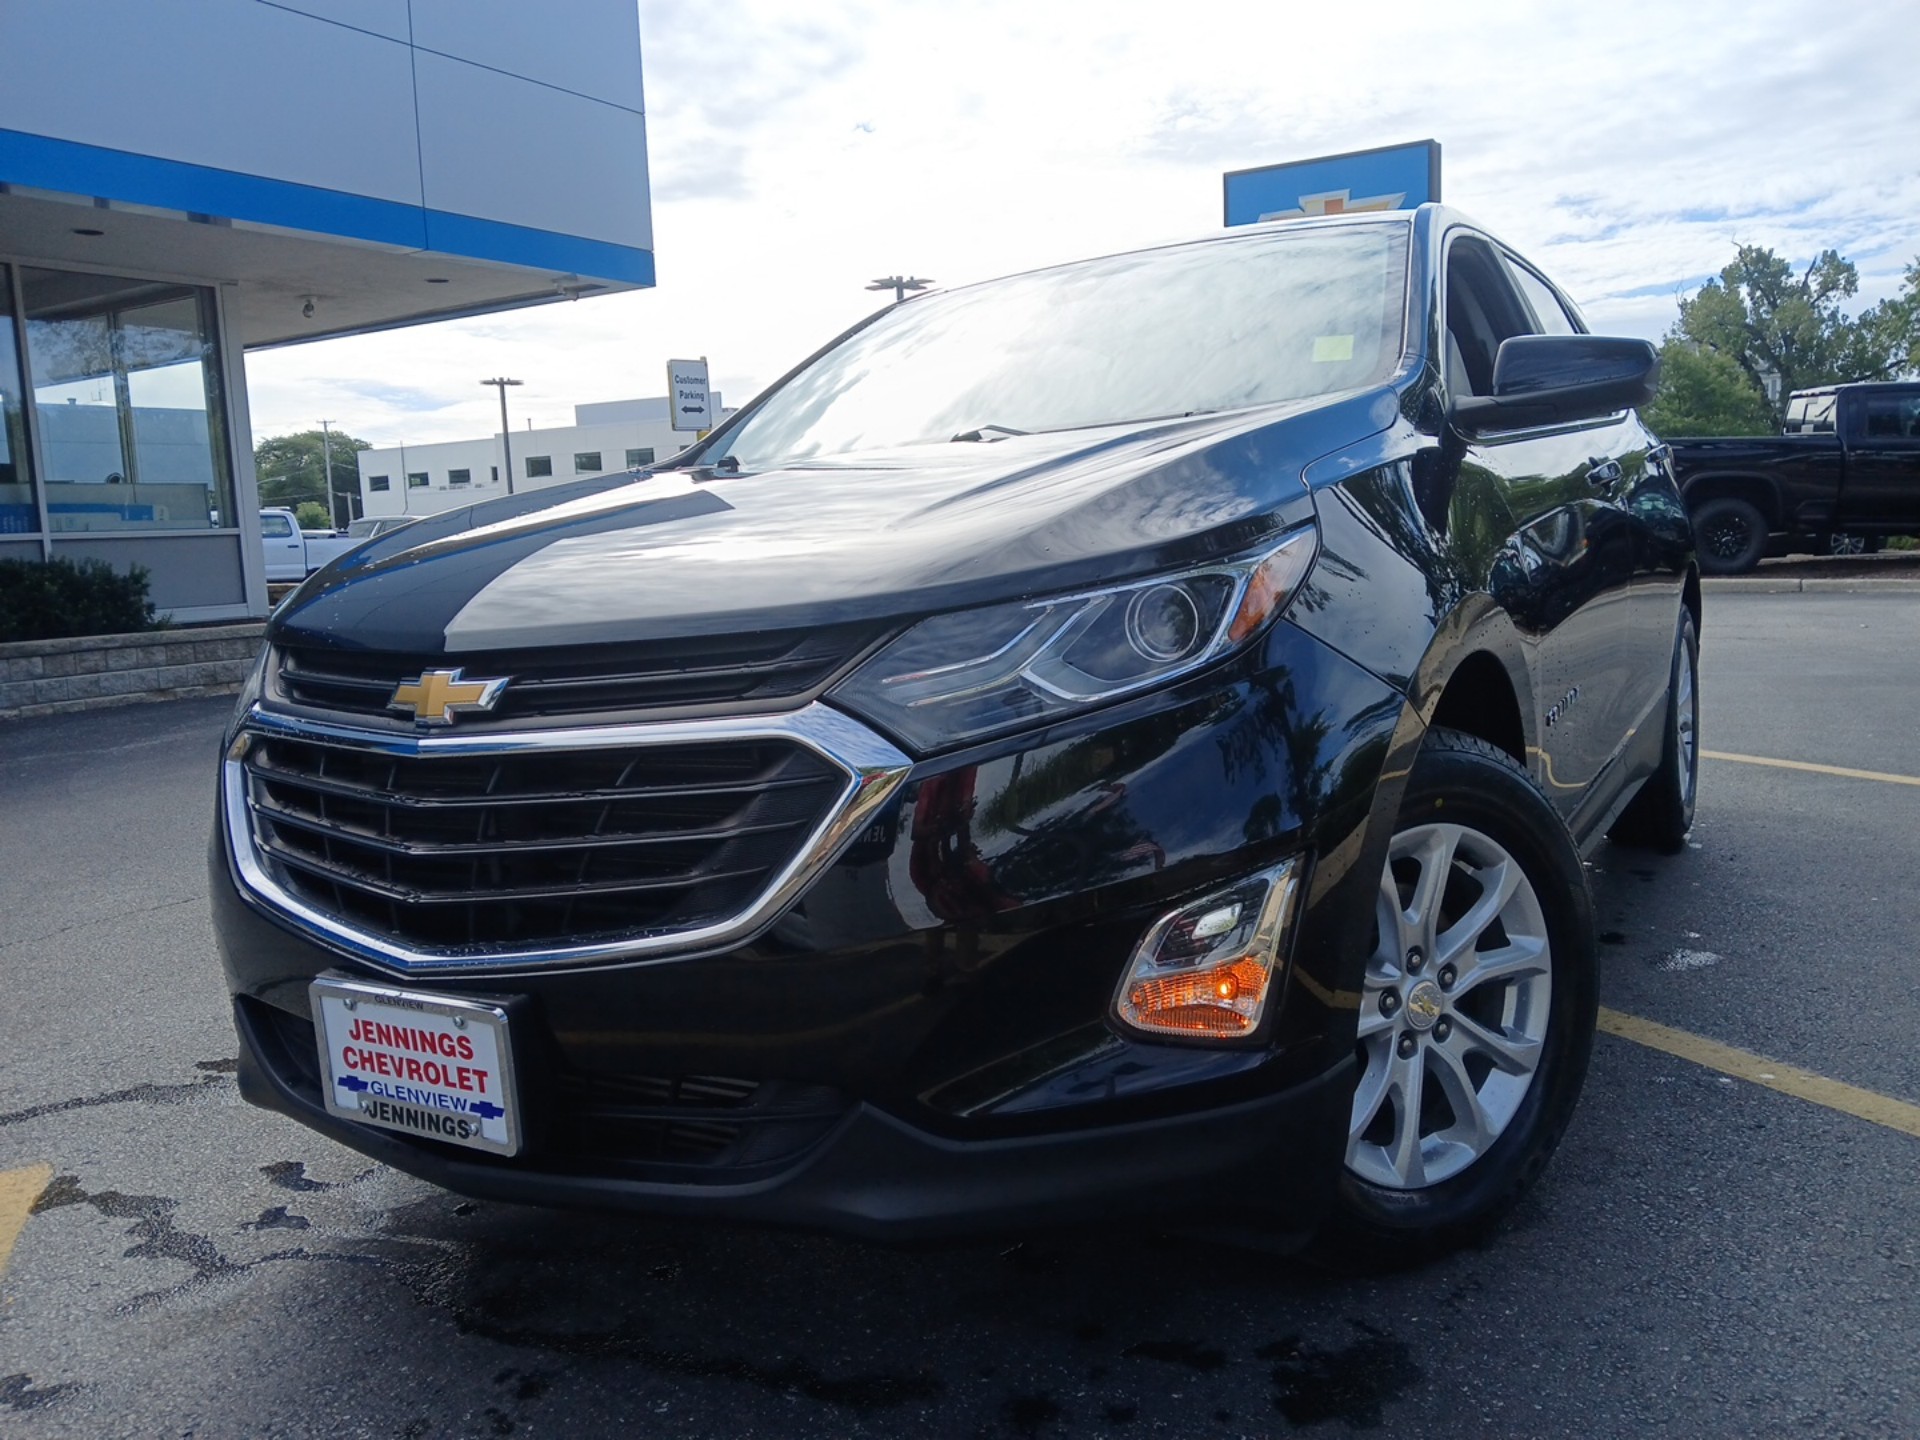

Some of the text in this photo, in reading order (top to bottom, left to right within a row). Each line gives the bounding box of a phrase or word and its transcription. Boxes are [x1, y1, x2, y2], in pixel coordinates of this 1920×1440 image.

[674, 374, 706, 385] Customer
[679, 390, 705, 402] Parking
[374, 994, 424, 1010] GLENVIEW
[349, 1018, 474, 1060] JENNINGS
[343, 1046, 488, 1093] CHEVROLET
[370, 1080, 468, 1112] GLENVIEW
[368, 1101, 471, 1139] JENNINGS
